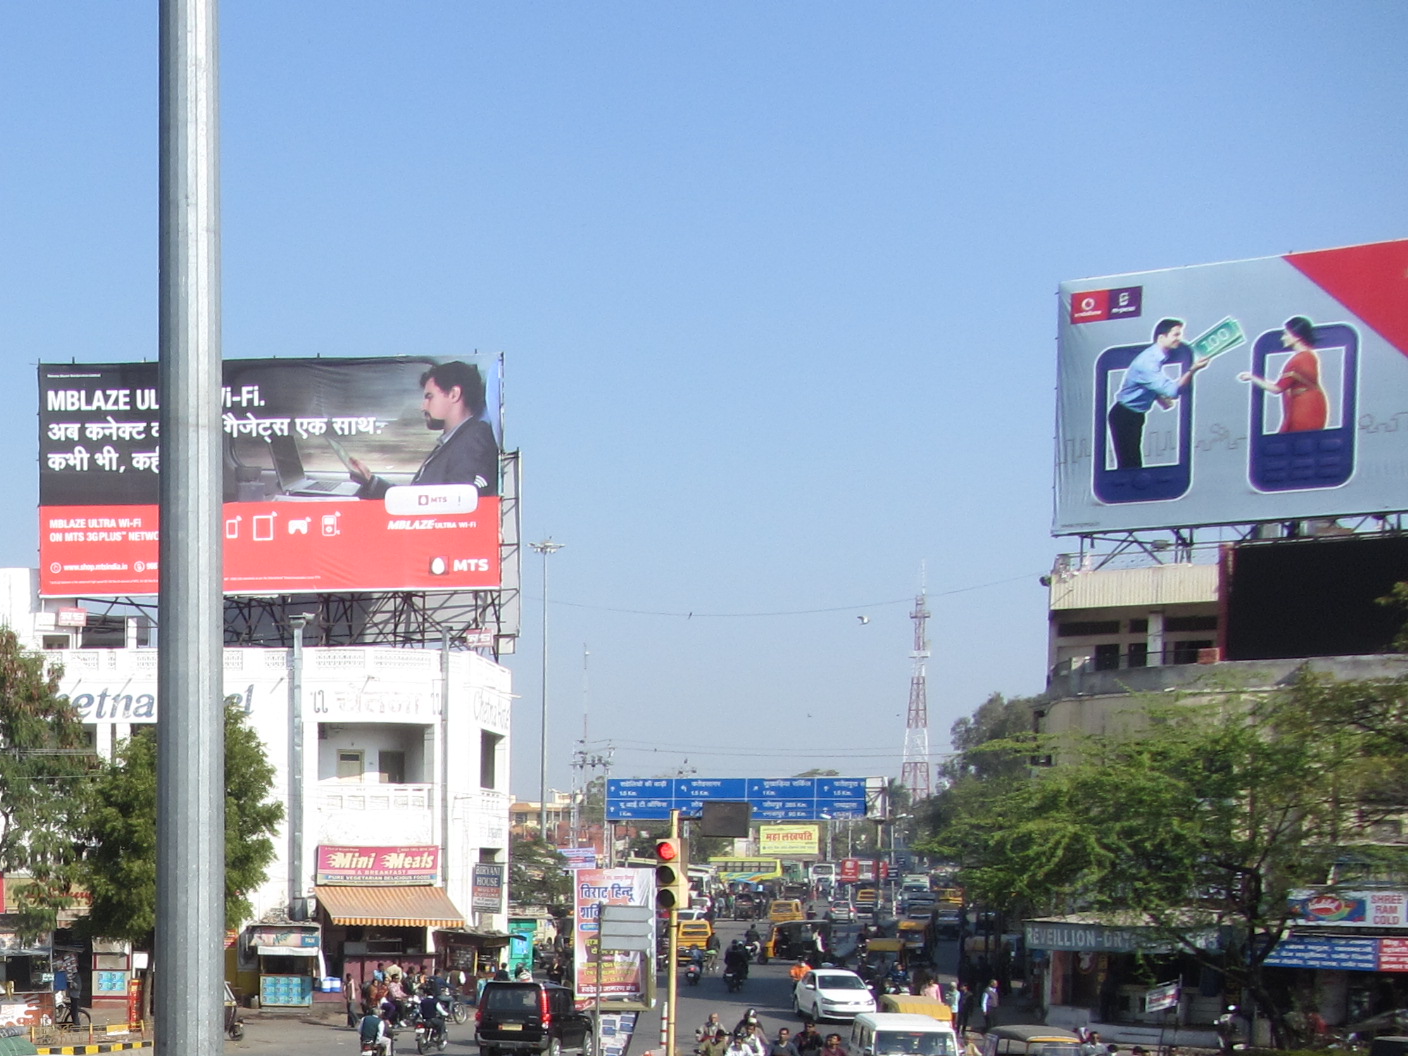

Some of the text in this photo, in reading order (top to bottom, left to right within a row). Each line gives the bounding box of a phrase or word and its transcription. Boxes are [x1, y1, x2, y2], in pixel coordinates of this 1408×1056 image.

[1201, 327, 1231, 348] 100
[47, 389, 131, 411] MBLAZE
[135, 388, 159, 410] UL
[47, 423, 81, 441] अब
[84, 416, 147, 441] कनेक्ट
[295, 417, 328, 439] एक
[47, 446, 90, 471] कभी
[94, 446, 126, 473] भी,
[49, 518, 142, 529] MBLAZE ULTRA Wi-Fi
[49, 532, 63, 543] ON
[64, 531, 85, 542] MTS
[453, 559, 489, 572] MTS
[332, 851, 435, 869] Mini Meals
[476, 876, 499, 887] HOUSE
[580, 882, 635, 903] विराट हिन्दू
[1370, 895, 1404, 905] SHREE
[1375, 905, 1398, 915] RAM
[1373, 915, 1401, 925] COLD
